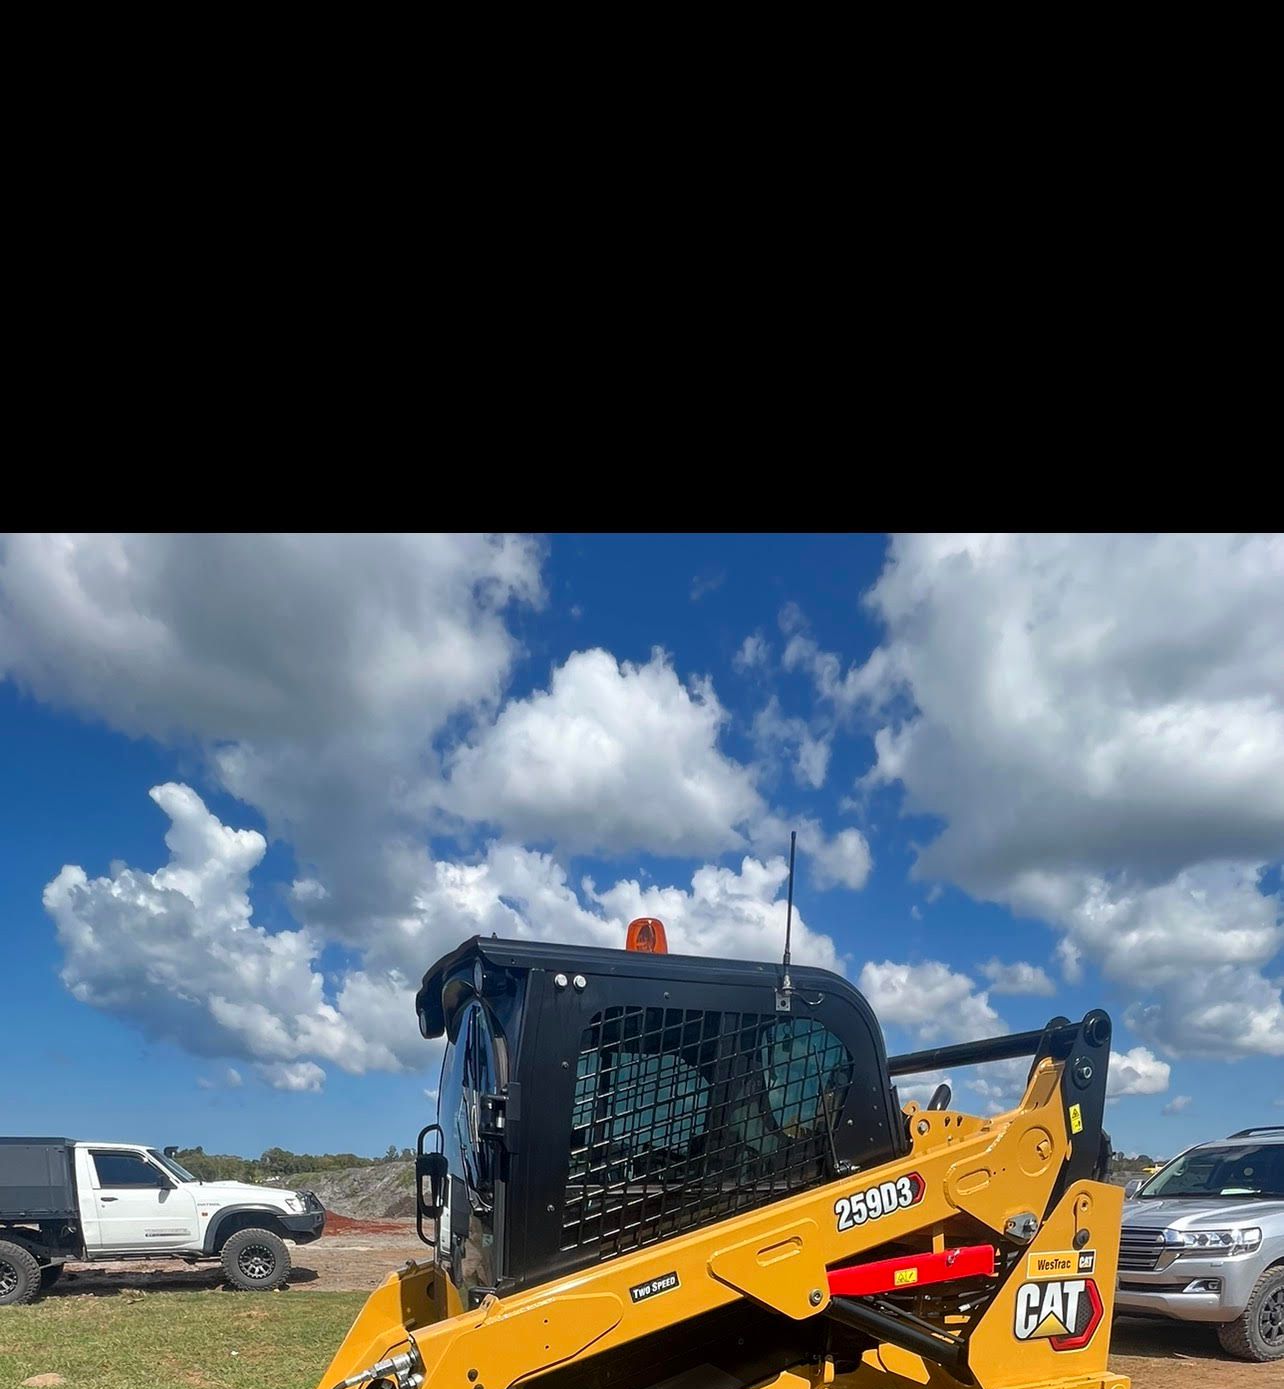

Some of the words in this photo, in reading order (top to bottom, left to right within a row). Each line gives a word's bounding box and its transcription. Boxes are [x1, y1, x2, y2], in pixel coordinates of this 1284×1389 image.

[835, 1176, 913, 1230] 259D3
[1037, 1258, 1071, 1270] WesTrac
[1079, 1256, 1093, 1269] CAT
[651, 1276, 676, 1292] SPEED
[1015, 1280, 1085, 1339] CAT
